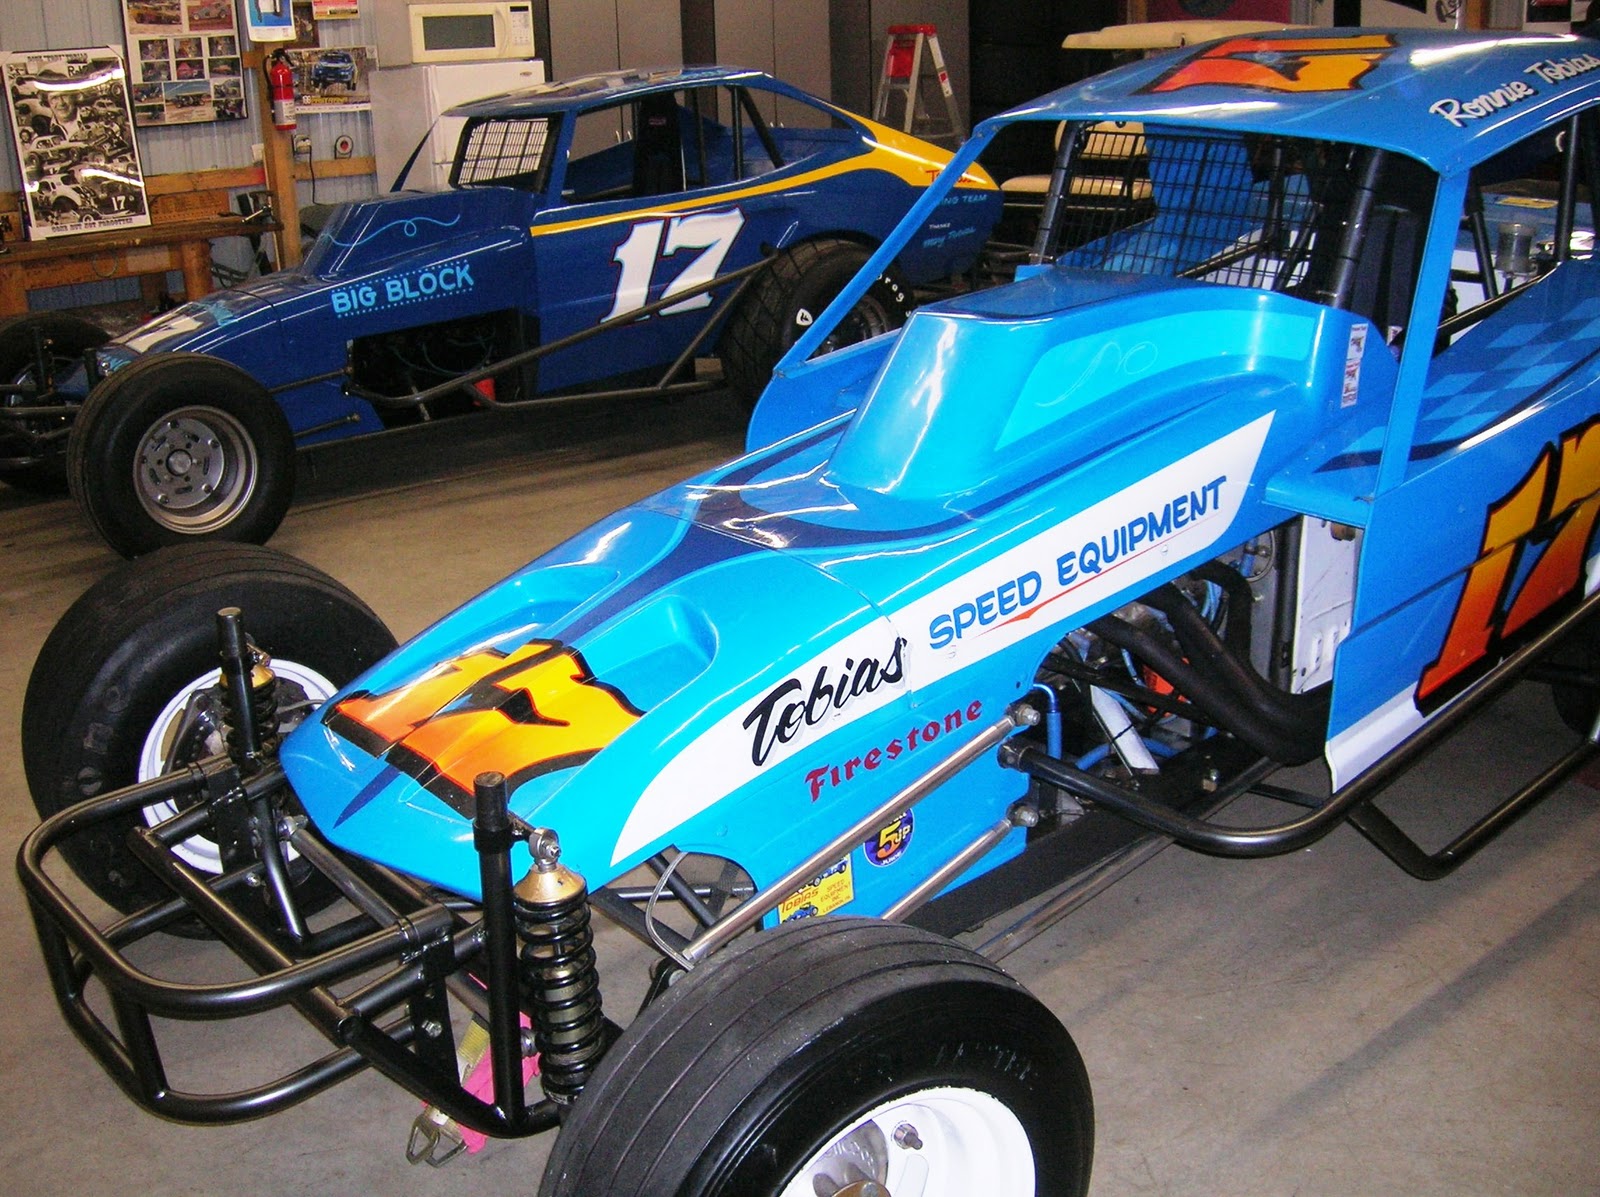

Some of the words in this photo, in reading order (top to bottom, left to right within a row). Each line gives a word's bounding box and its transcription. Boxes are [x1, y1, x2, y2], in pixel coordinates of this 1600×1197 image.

[1429, 80, 1537, 128] Ronnie
[1523, 53, 1600, 84] Tobias
[112, 195, 126, 212] 17
[962, 194, 987, 203] TEAM
[331, 286, 377, 313] BIG
[385, 264, 475, 302] BLOCK
[598, 206, 746, 322] 17
[929, 570, 1042, 650] SPEED
[1056, 475, 1227, 587] EQUIPMENT
[1413, 412, 1600, 717] 17
[742, 637, 908, 767] Tobias
[804, 700, 983, 803] Firestone
[780, 887, 820, 913] TOBIAS
